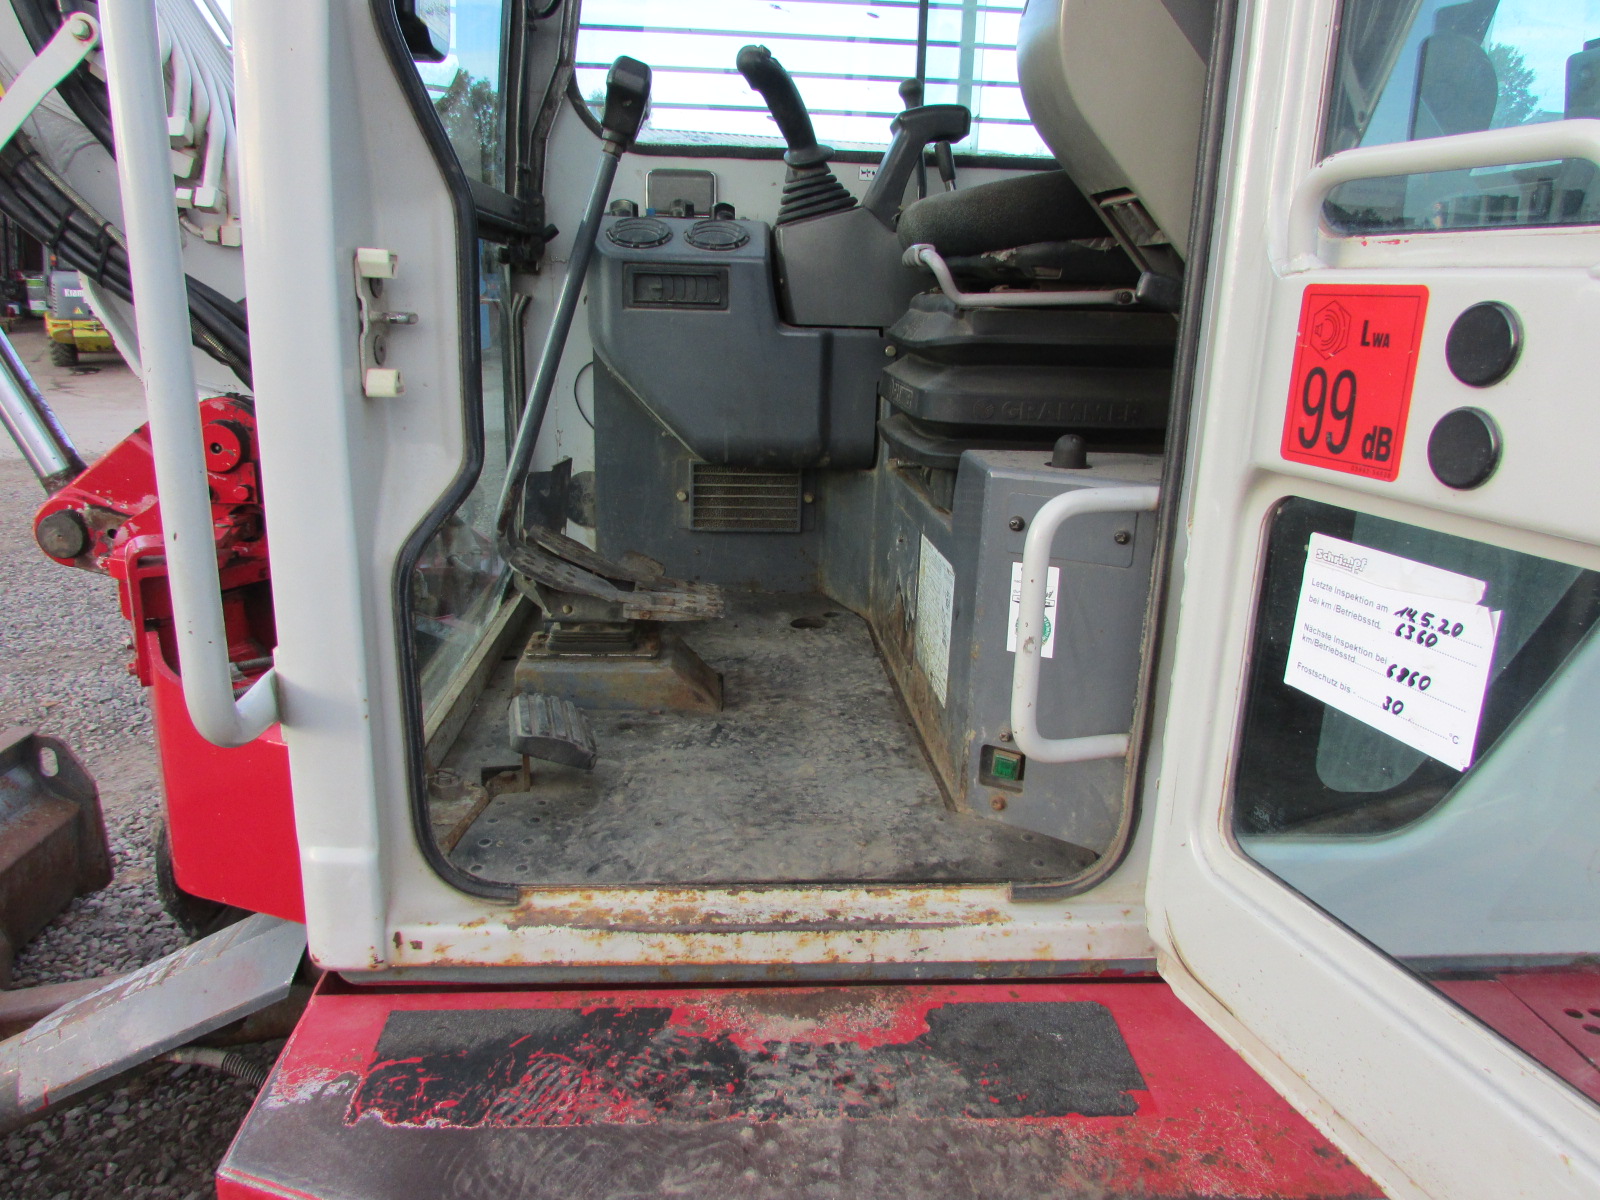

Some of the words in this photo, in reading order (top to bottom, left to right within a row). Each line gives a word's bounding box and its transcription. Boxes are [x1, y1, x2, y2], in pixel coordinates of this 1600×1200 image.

[1297, 365, 1357, 454] 99
[1361, 425, 1393, 462] dB
[1308, 594, 1320, 605] bei
[1321, 599, 1332, 610] km
[1311, 577, 1333, 592] Letzte
[1334, 586, 1374, 608] Inspektion
[1376, 602, 1388, 613] am
[1304, 622, 1332, 640] Nächste
[1333, 635, 1373, 658] Inspektion
[1375, 653, 1388, 664] bei
[1395, 623, 1438, 648] 6360
[1297, 661, 1338, 687] Frostschutz
[1339, 682, 1351, 694] bis
[1382, 695, 1404, 715] 30
[1448, 732, 1460, 745] °C
